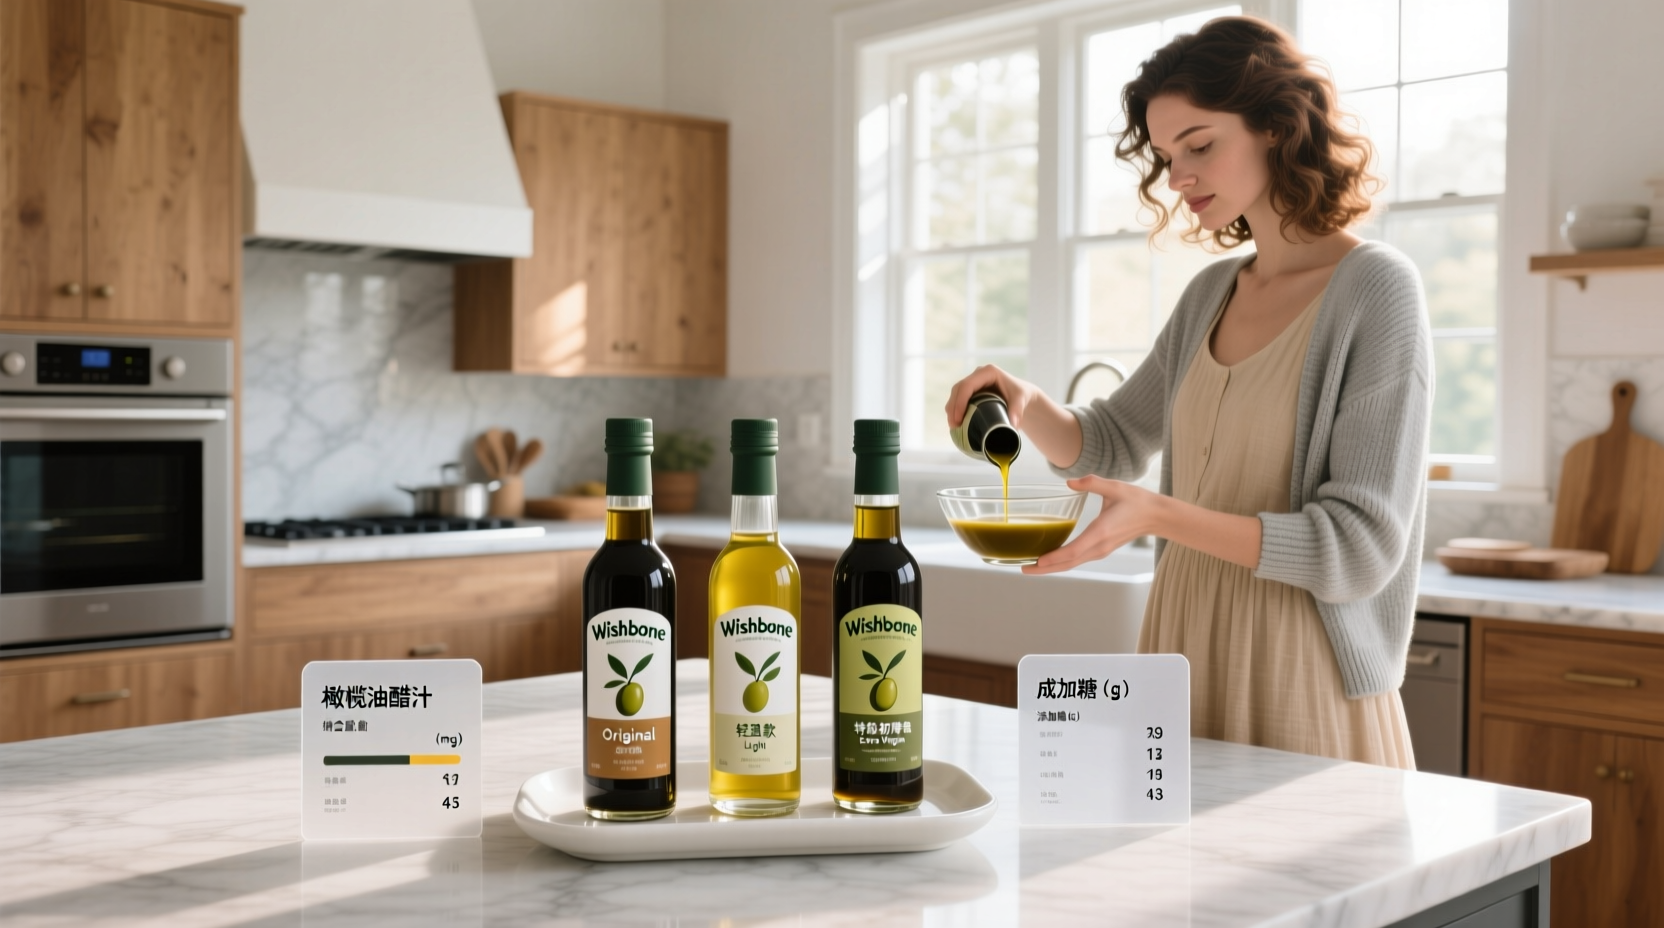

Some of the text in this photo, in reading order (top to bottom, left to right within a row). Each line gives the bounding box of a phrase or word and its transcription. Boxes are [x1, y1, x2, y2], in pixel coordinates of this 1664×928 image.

[591, 619, 666, 641] Wishbone
[720, 616, 793, 638] Wishbone
[321, 685, 433, 709] 橄榄油醋汁
[1103, 679, 1129, 701] (g)
[436, 732, 463, 748] (mg)
[602, 727, 656, 745] Original
[442, 796, 460, 809] 45
[1146, 787, 1164, 801] 43
